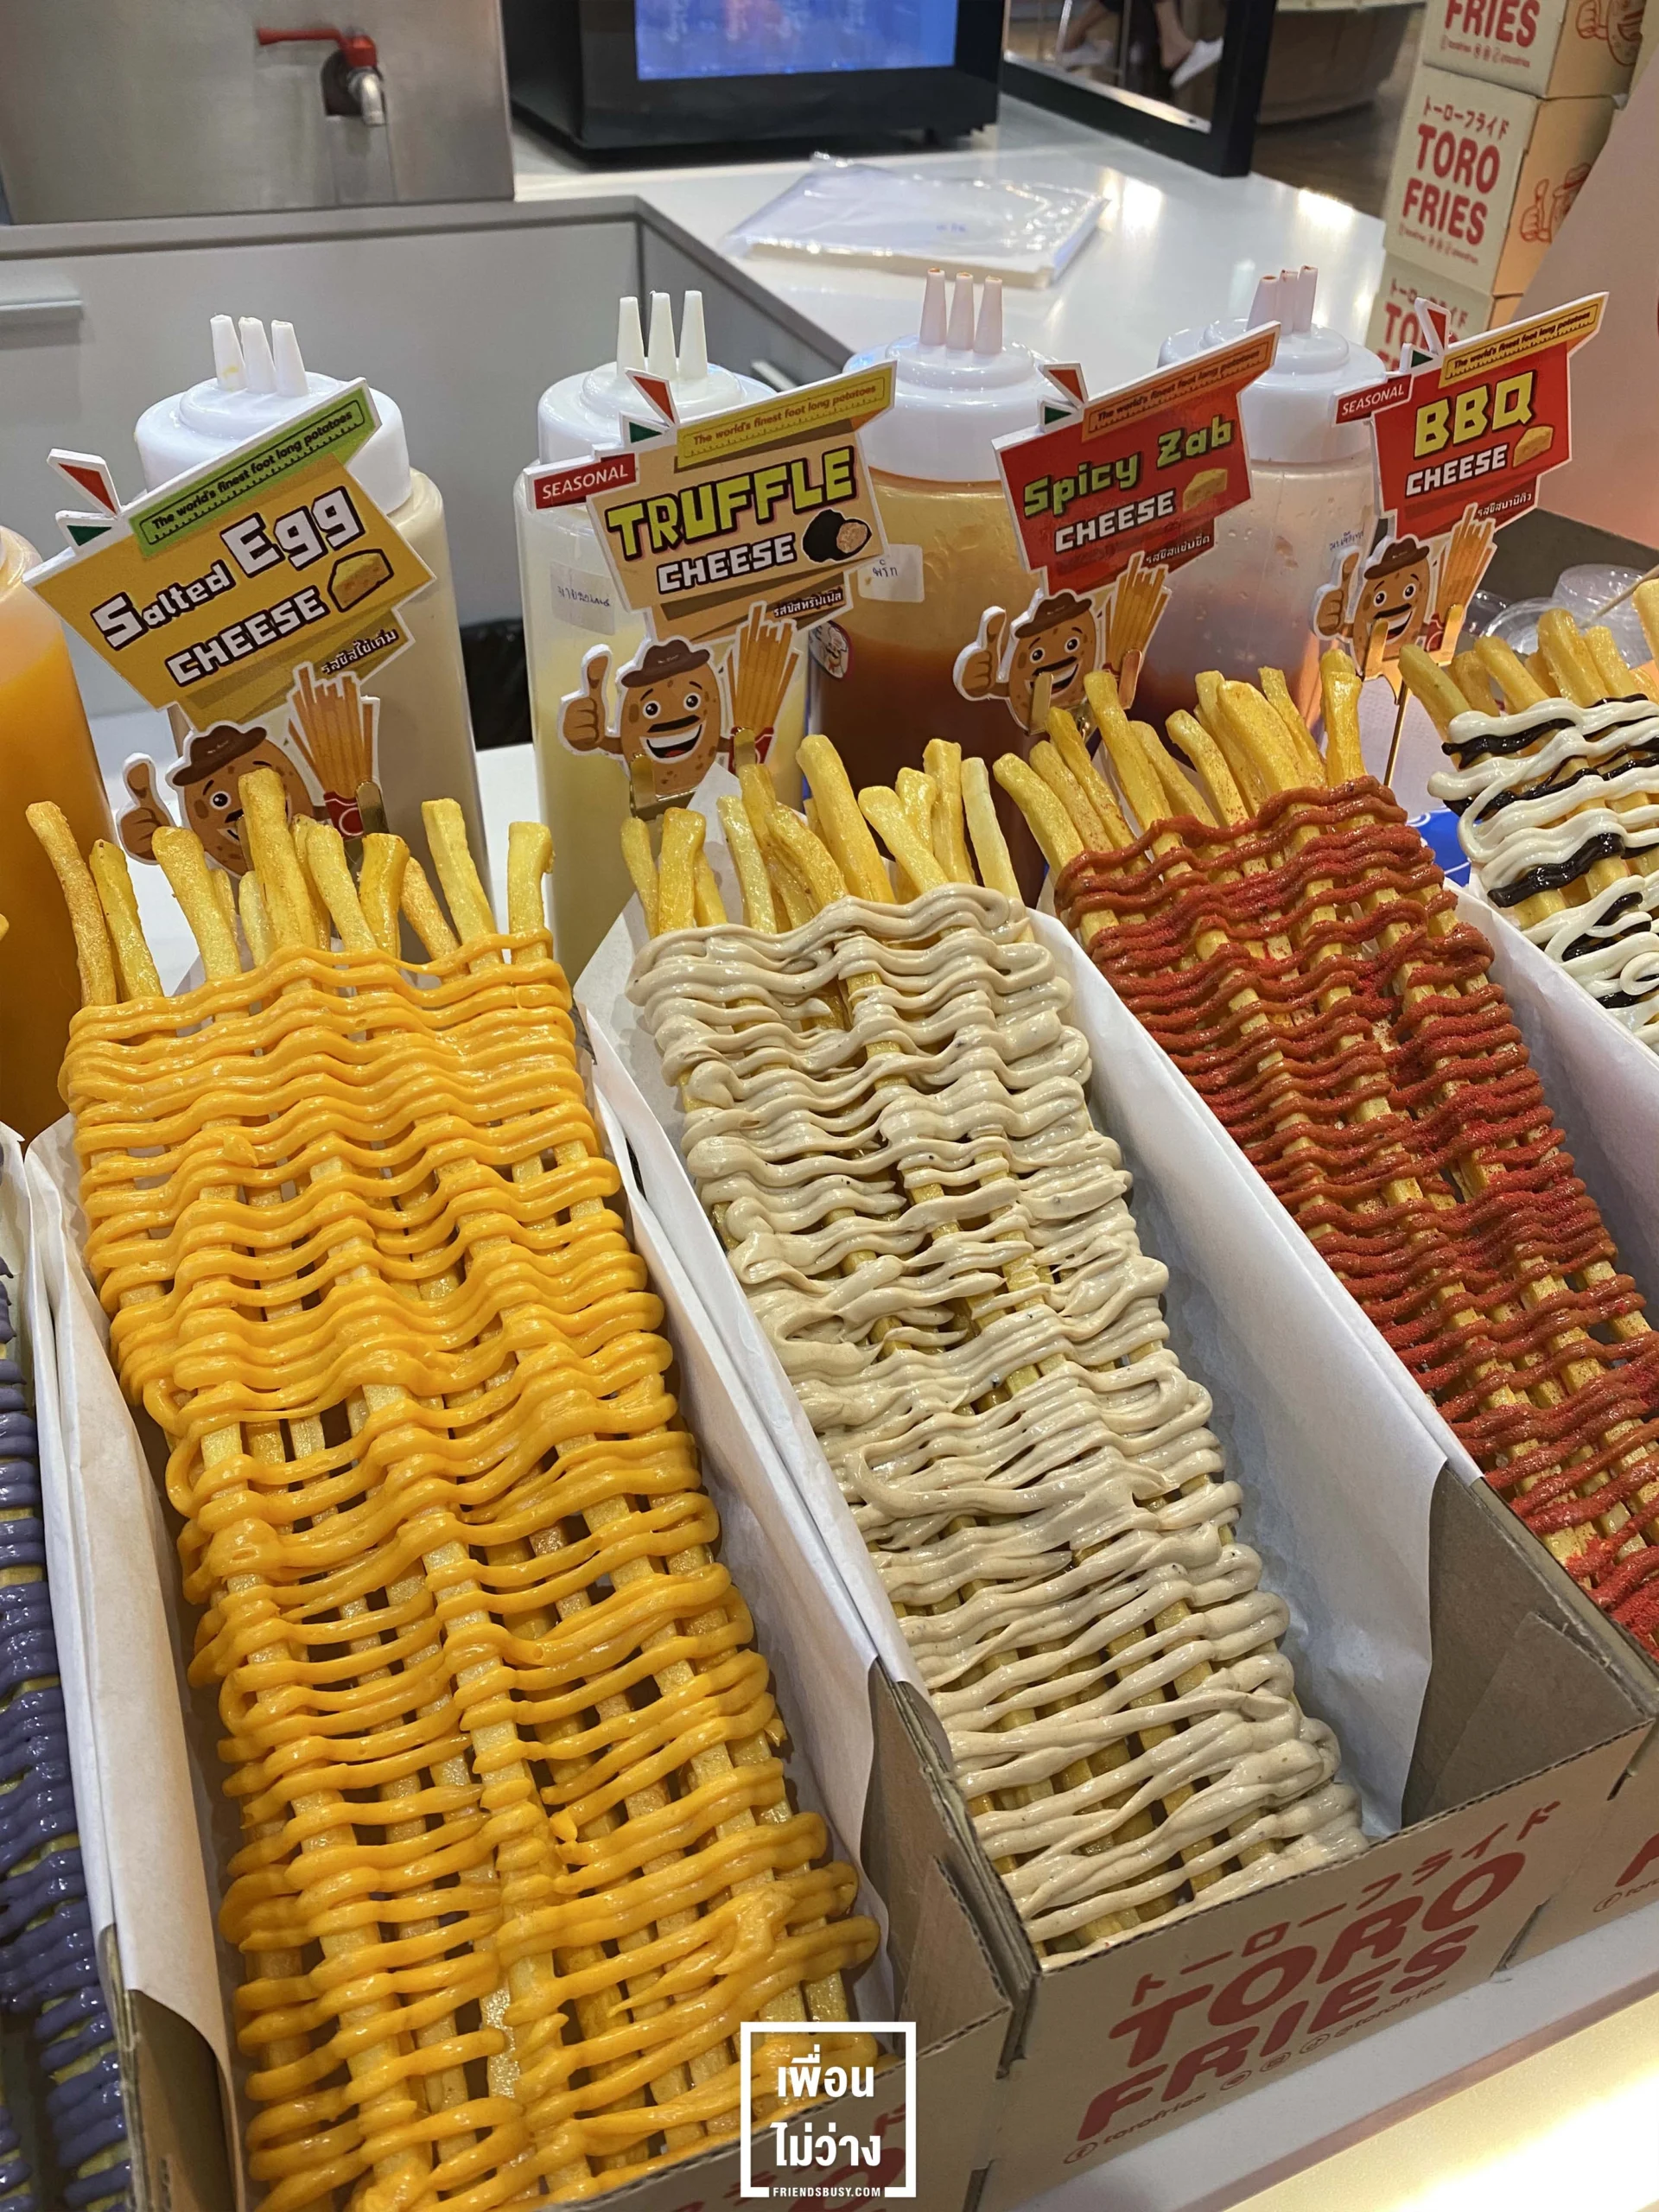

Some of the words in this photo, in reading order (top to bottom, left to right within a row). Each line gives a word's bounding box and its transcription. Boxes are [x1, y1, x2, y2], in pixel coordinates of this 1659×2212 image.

[1417, 123, 1500, 194] TORO
[1402, 177, 1487, 245] FRIES
[1454, 356, 1468, 370] The
[1470, 346, 1497, 364] world's
[1498, 336, 1520, 353] finest
[1521, 330, 1538, 344] foot
[694, 435, 712, 446] The
[715, 422, 750, 439] world's
[753, 413, 782, 427] finest
[785, 406, 805, 418] foot
[809, 398, 830, 412] long
[832, 385, 876, 406] potatoes
[1097, 409, 1115, 422] The
[1116, 395, 1147, 415] world's
[1150, 384, 1176, 400] finest
[1341, 384, 1404, 416] SEASONAL
[1413, 370, 1538, 459] BBQ
[152, 514, 175, 530] The
[176, 486, 216, 516] world's
[217, 469, 250, 493] finest
[251, 454, 276, 474] foot
[276, 440, 302, 461] long
[303, 410, 353, 446] potatoes
[543, 467, 629, 500] SEASONAL
[1023, 452, 1139, 518] Spicy
[1156, 415, 1234, 471] Zab
[1405, 443, 1508, 497] CHEESE
[605, 444, 857, 562] TRUFFLE
[1054, 490, 1176, 553] CHEESE
[92, 562, 235, 650] Salted
[222, 486, 364, 577] Egg
[657, 533, 797, 596] CHEESE
[168, 586, 330, 686] CHEESE
[1109, 1852, 1527, 2068] TORO
[1077, 1925, 1478, 2141] FRIES
[1103, 2092, 1207, 2145] torofries
